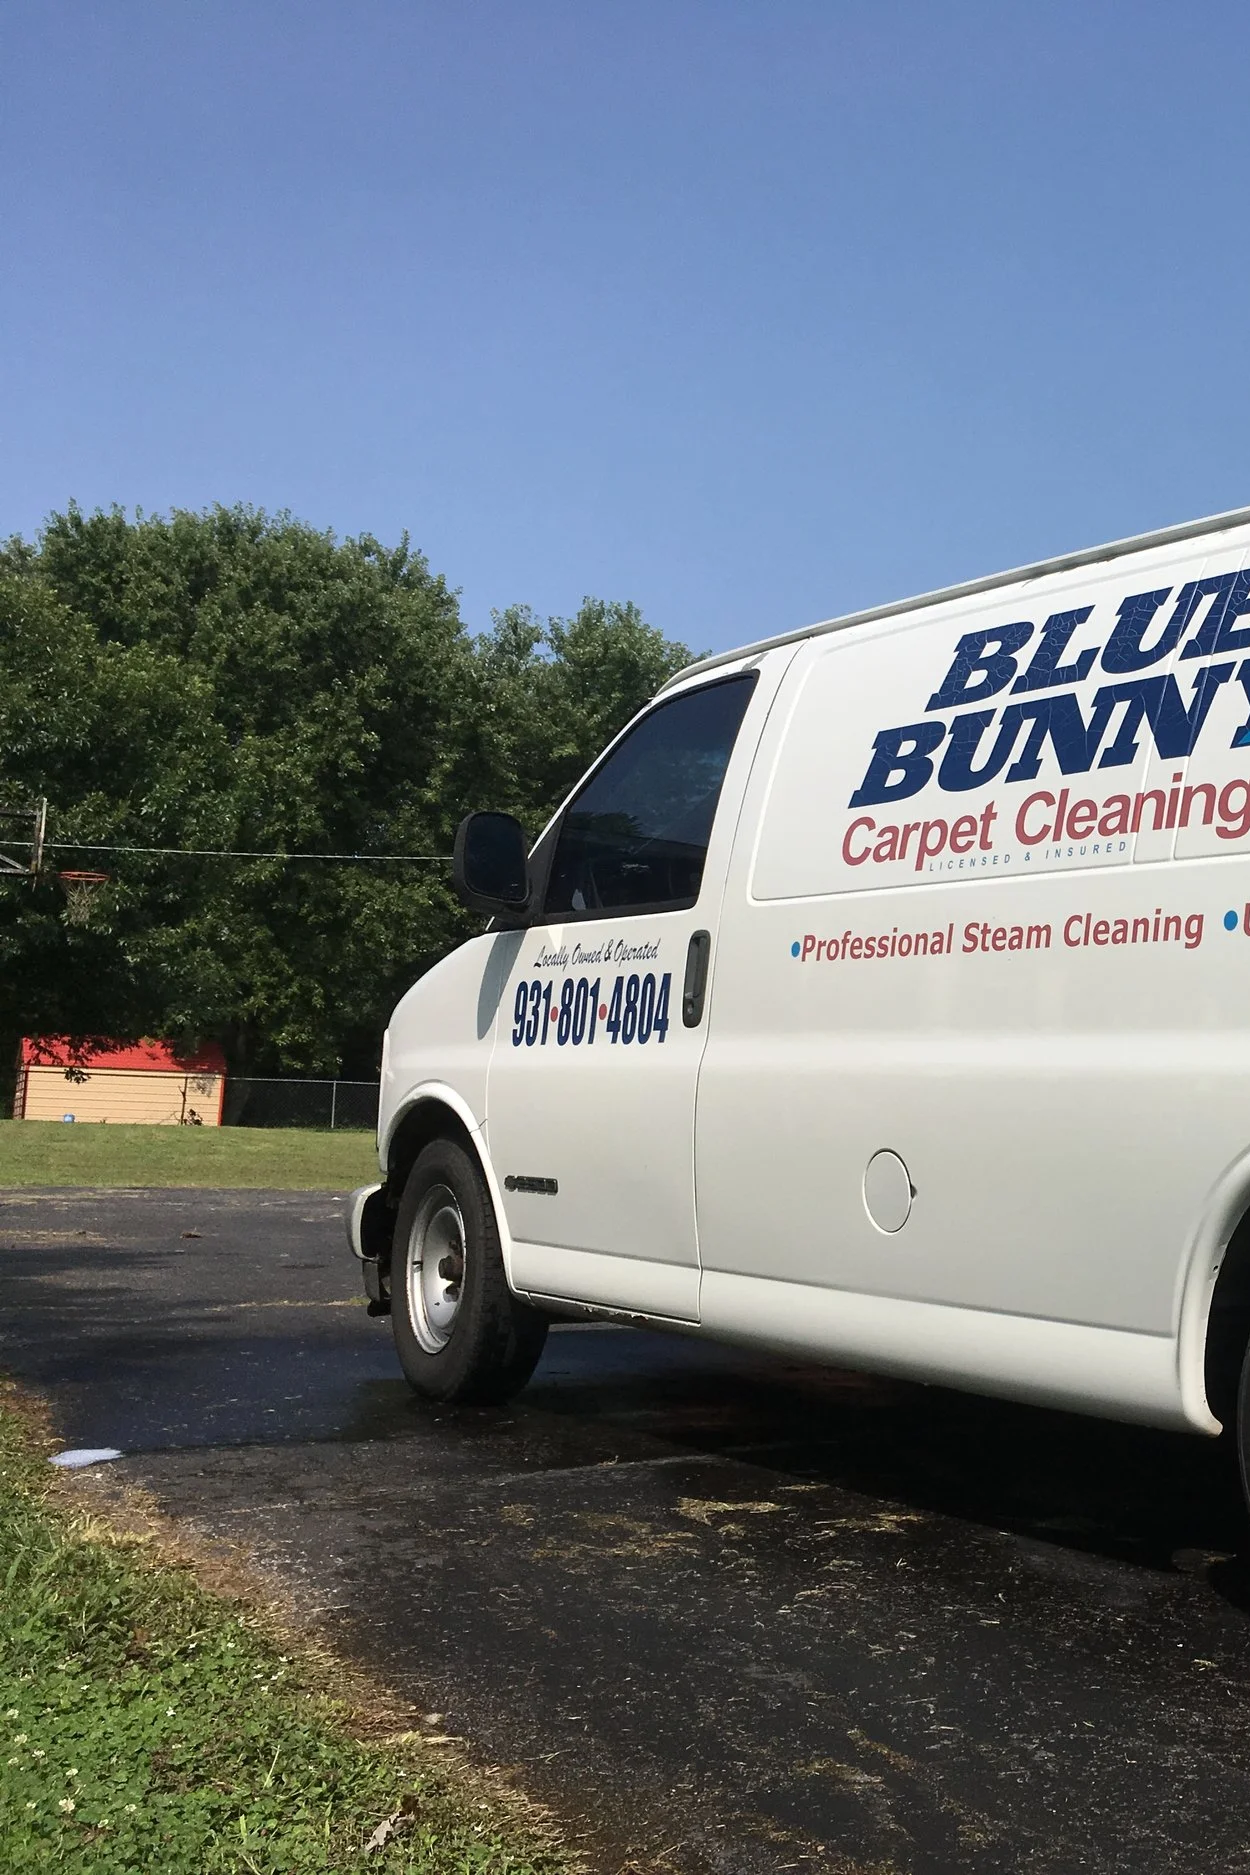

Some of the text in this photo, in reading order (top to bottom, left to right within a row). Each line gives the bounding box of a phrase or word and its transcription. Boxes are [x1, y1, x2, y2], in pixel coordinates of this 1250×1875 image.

[842, 800, 997, 871] Carpet
[929, 854, 1011, 872] LICENSED
[1045, 841, 1126, 859] INSURED
[533, 937, 661, 972] Locally Owned & Operated
[801, 908, 1205, 962] Professional Steam Cleaning
